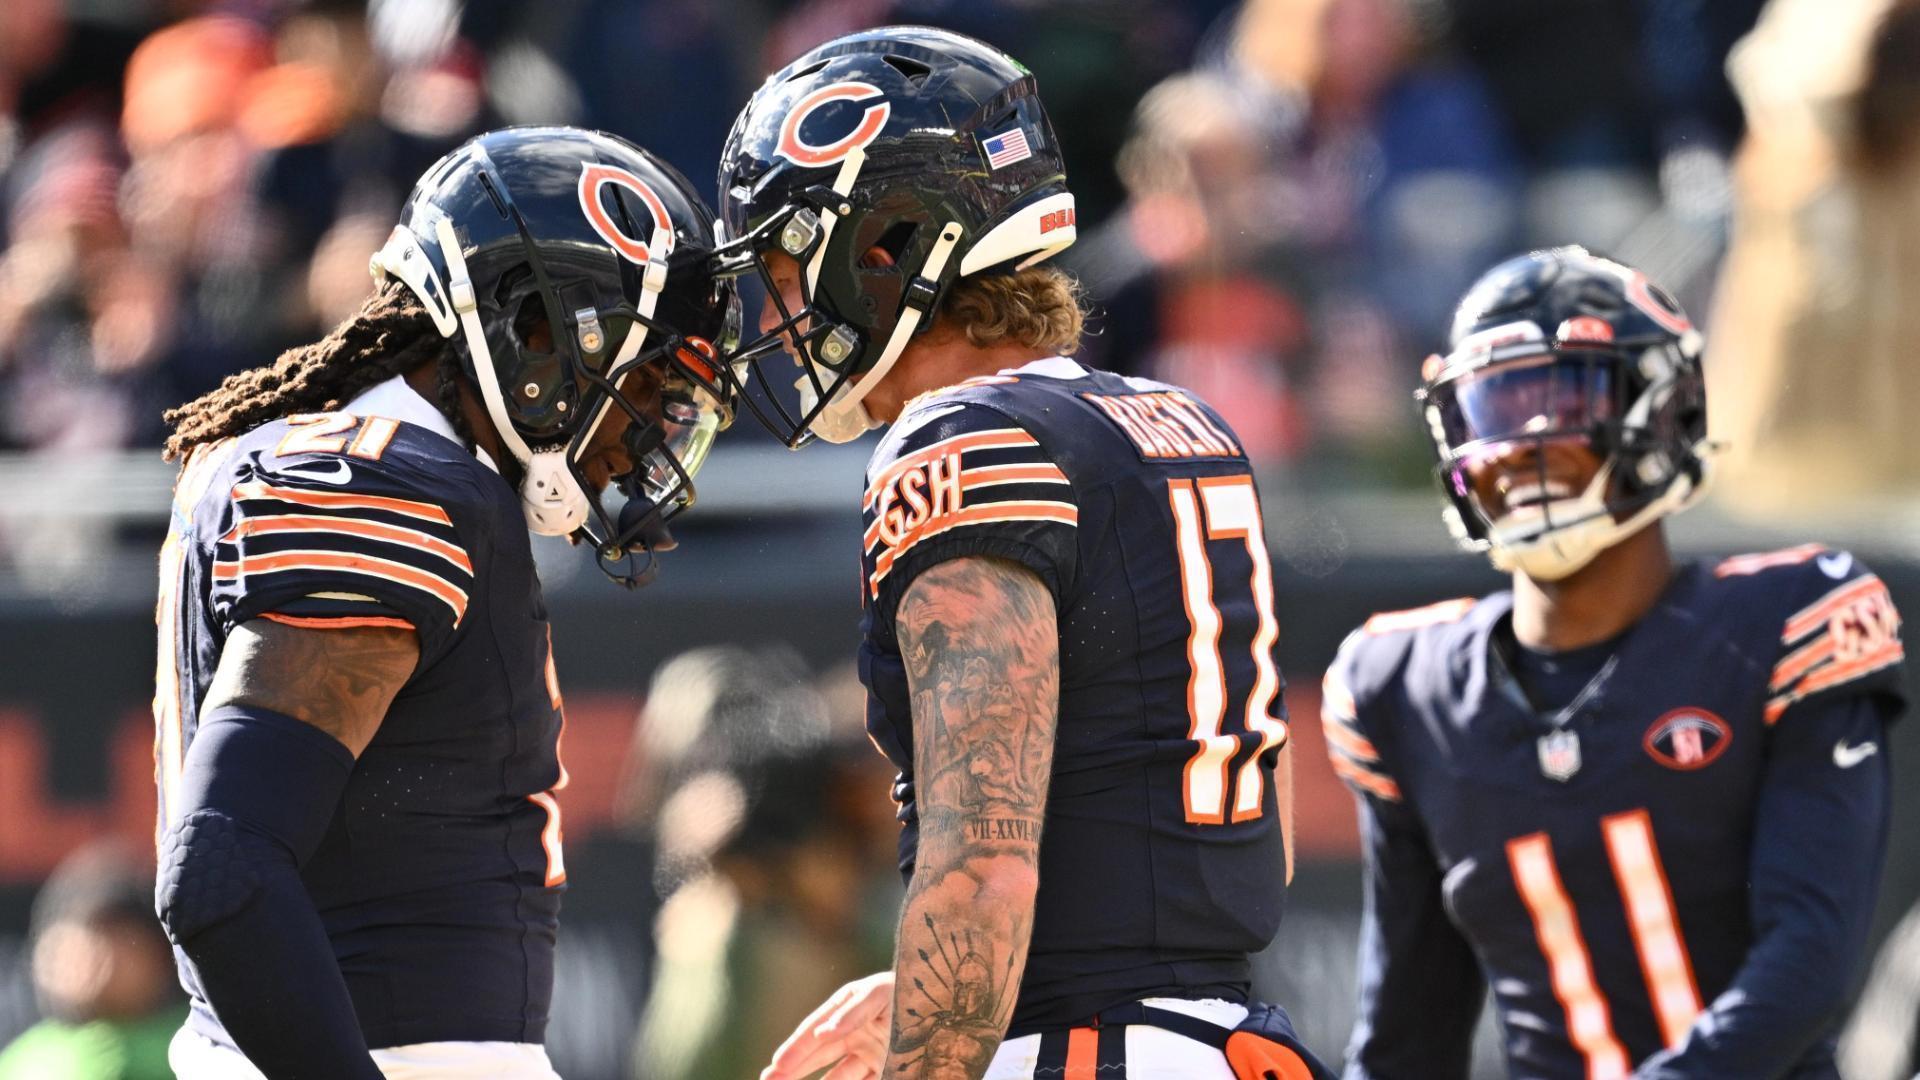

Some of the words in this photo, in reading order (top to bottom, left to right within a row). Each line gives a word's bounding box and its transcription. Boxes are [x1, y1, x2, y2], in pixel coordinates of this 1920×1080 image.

[274, 411, 400, 461] 21
[1081, 391, 1241, 458] BAGENT
[878, 449, 963, 547] GSH
[1167, 474, 1288, 825] 17
[1506, 808, 1704, 1080] 11
